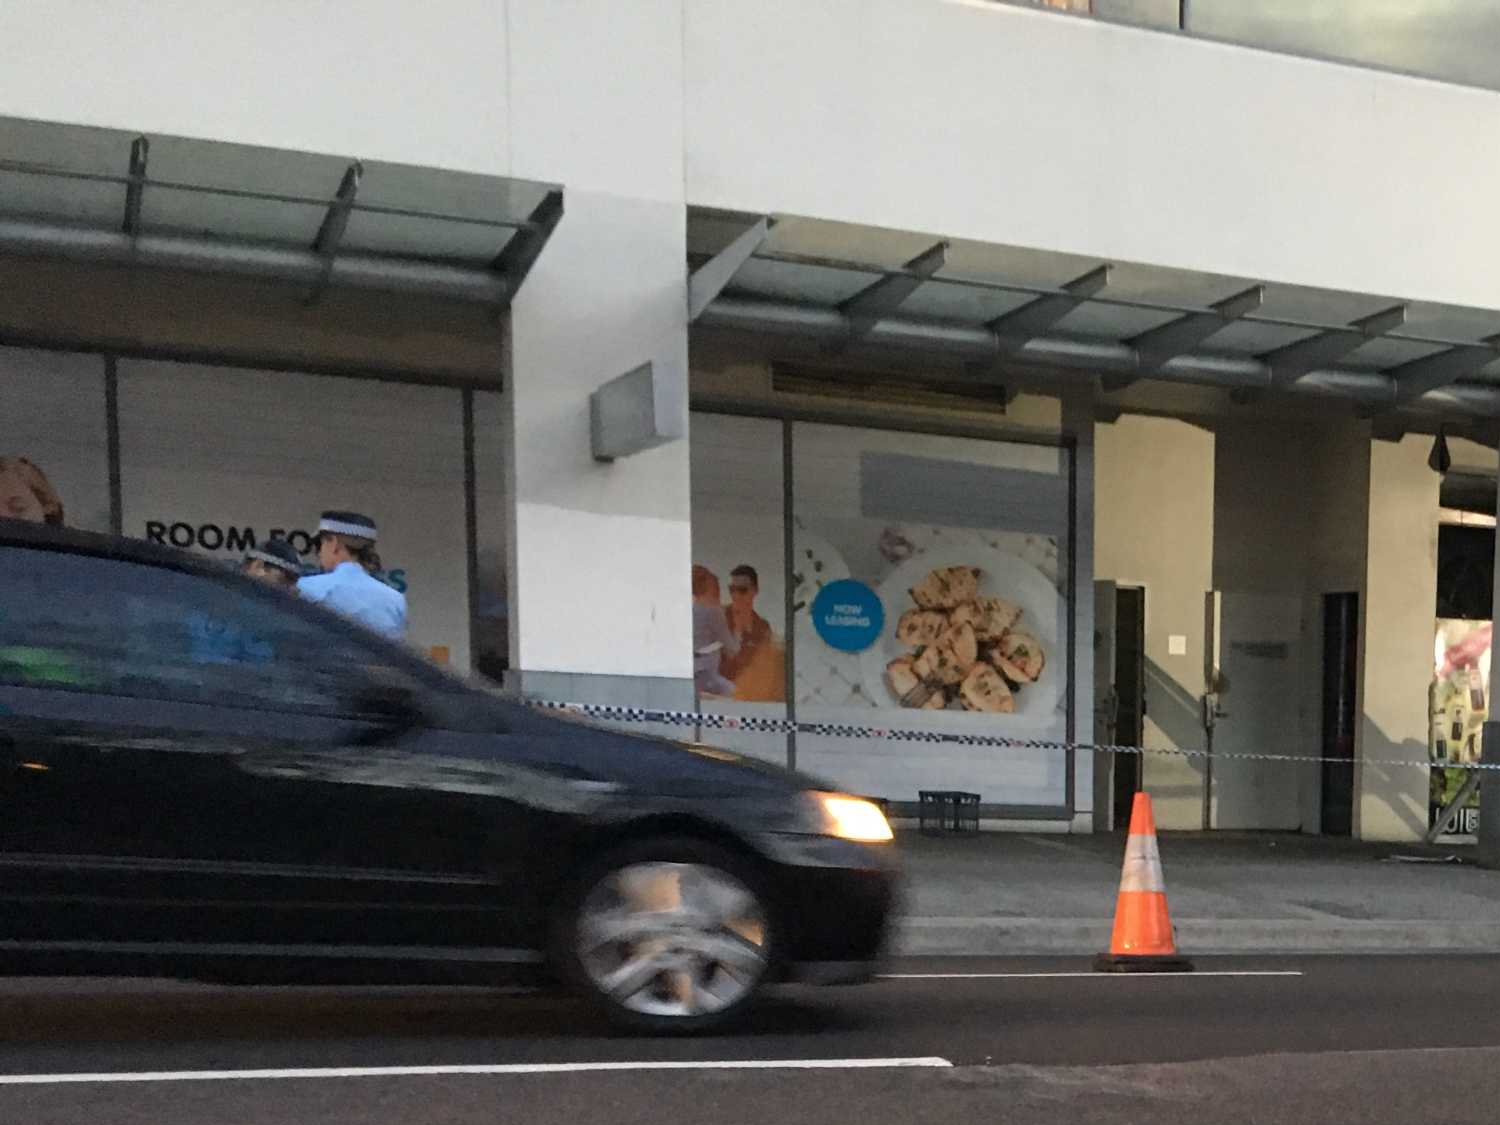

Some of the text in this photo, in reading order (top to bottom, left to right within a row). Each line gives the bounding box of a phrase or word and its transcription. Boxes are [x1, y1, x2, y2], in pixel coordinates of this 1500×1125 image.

[146, 521, 255, 551] ROOM
[833, 604, 863, 616] NOW
[824, 615, 871, 627] LEASING
